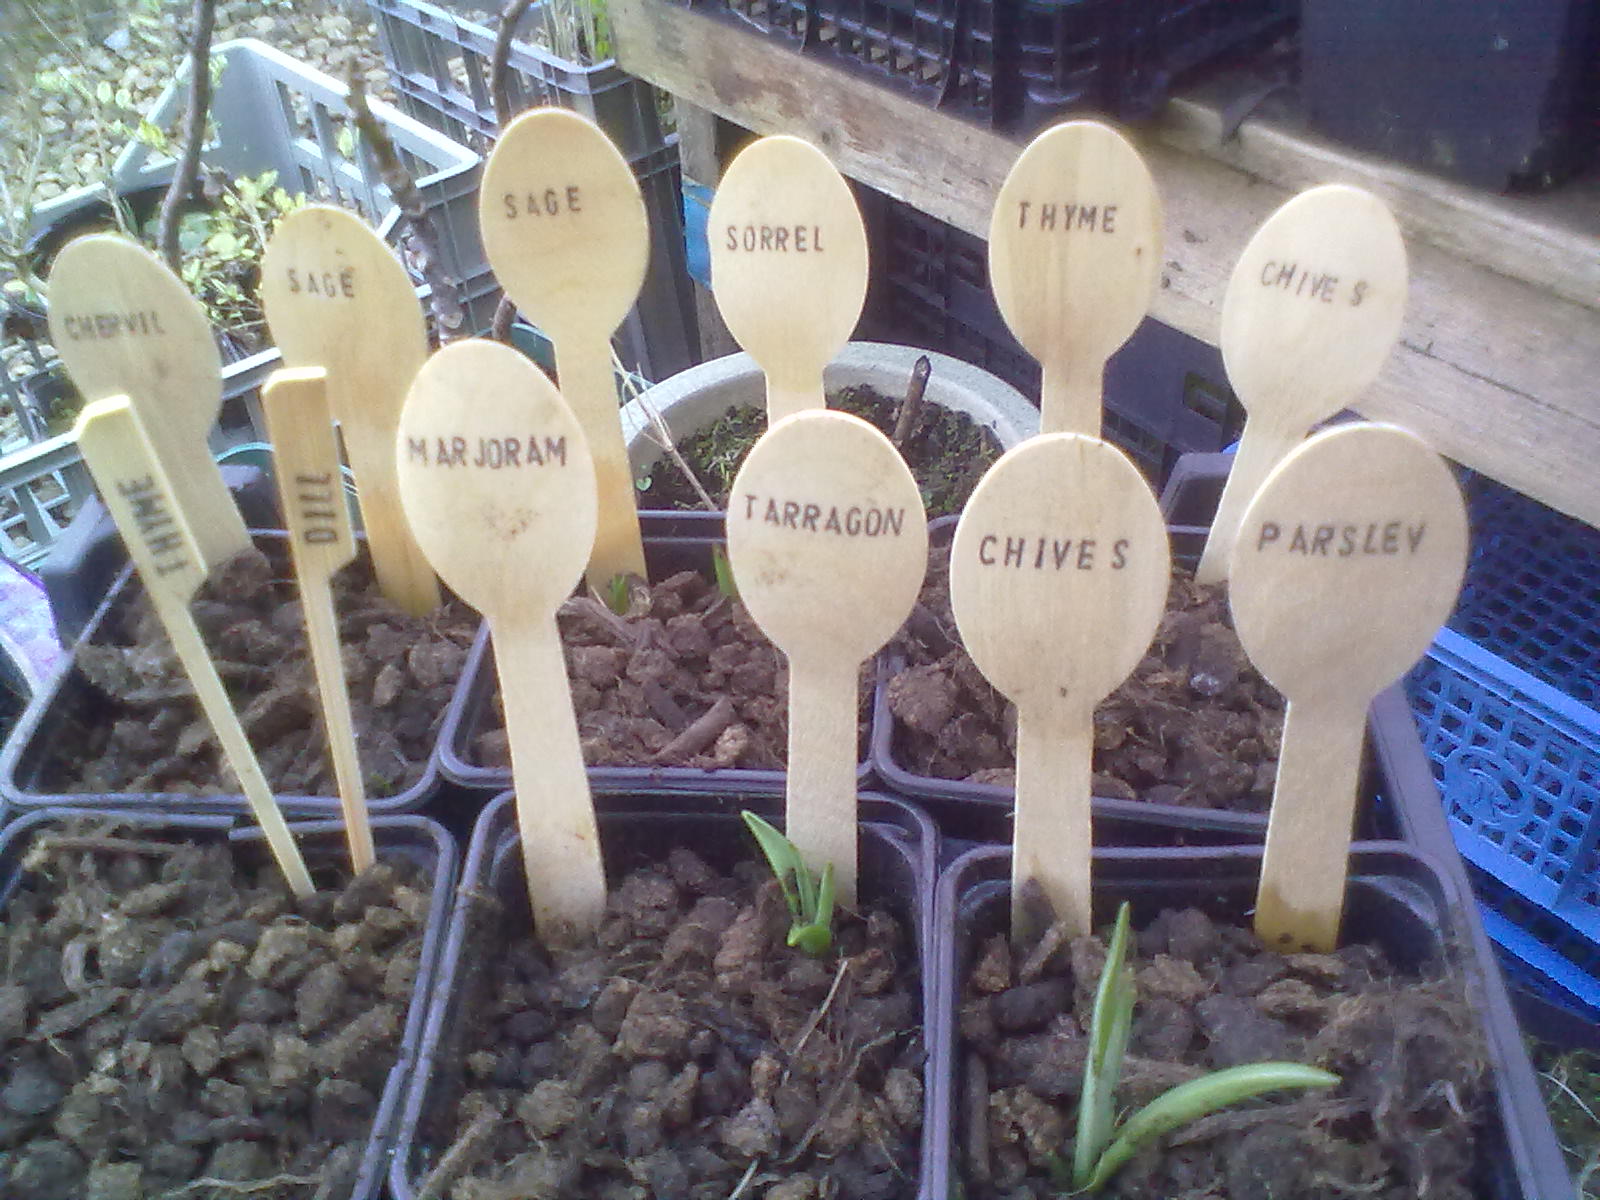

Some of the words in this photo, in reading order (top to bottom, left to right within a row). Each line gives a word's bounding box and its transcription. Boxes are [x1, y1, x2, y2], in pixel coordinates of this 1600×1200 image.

[503, 186, 582, 219] SAGE
[1017, 201, 1118, 234] THYME
[726, 225, 825, 252] SORREL
[287, 266, 356, 298] SAGE
[407, 436, 567, 470] MARJORAM
[117, 473, 189, 577] THYME
[296, 472, 338, 544] DILL
[744, 494, 906, 538] TARRAGON
[1257, 521, 1428, 557] PARSLEY
